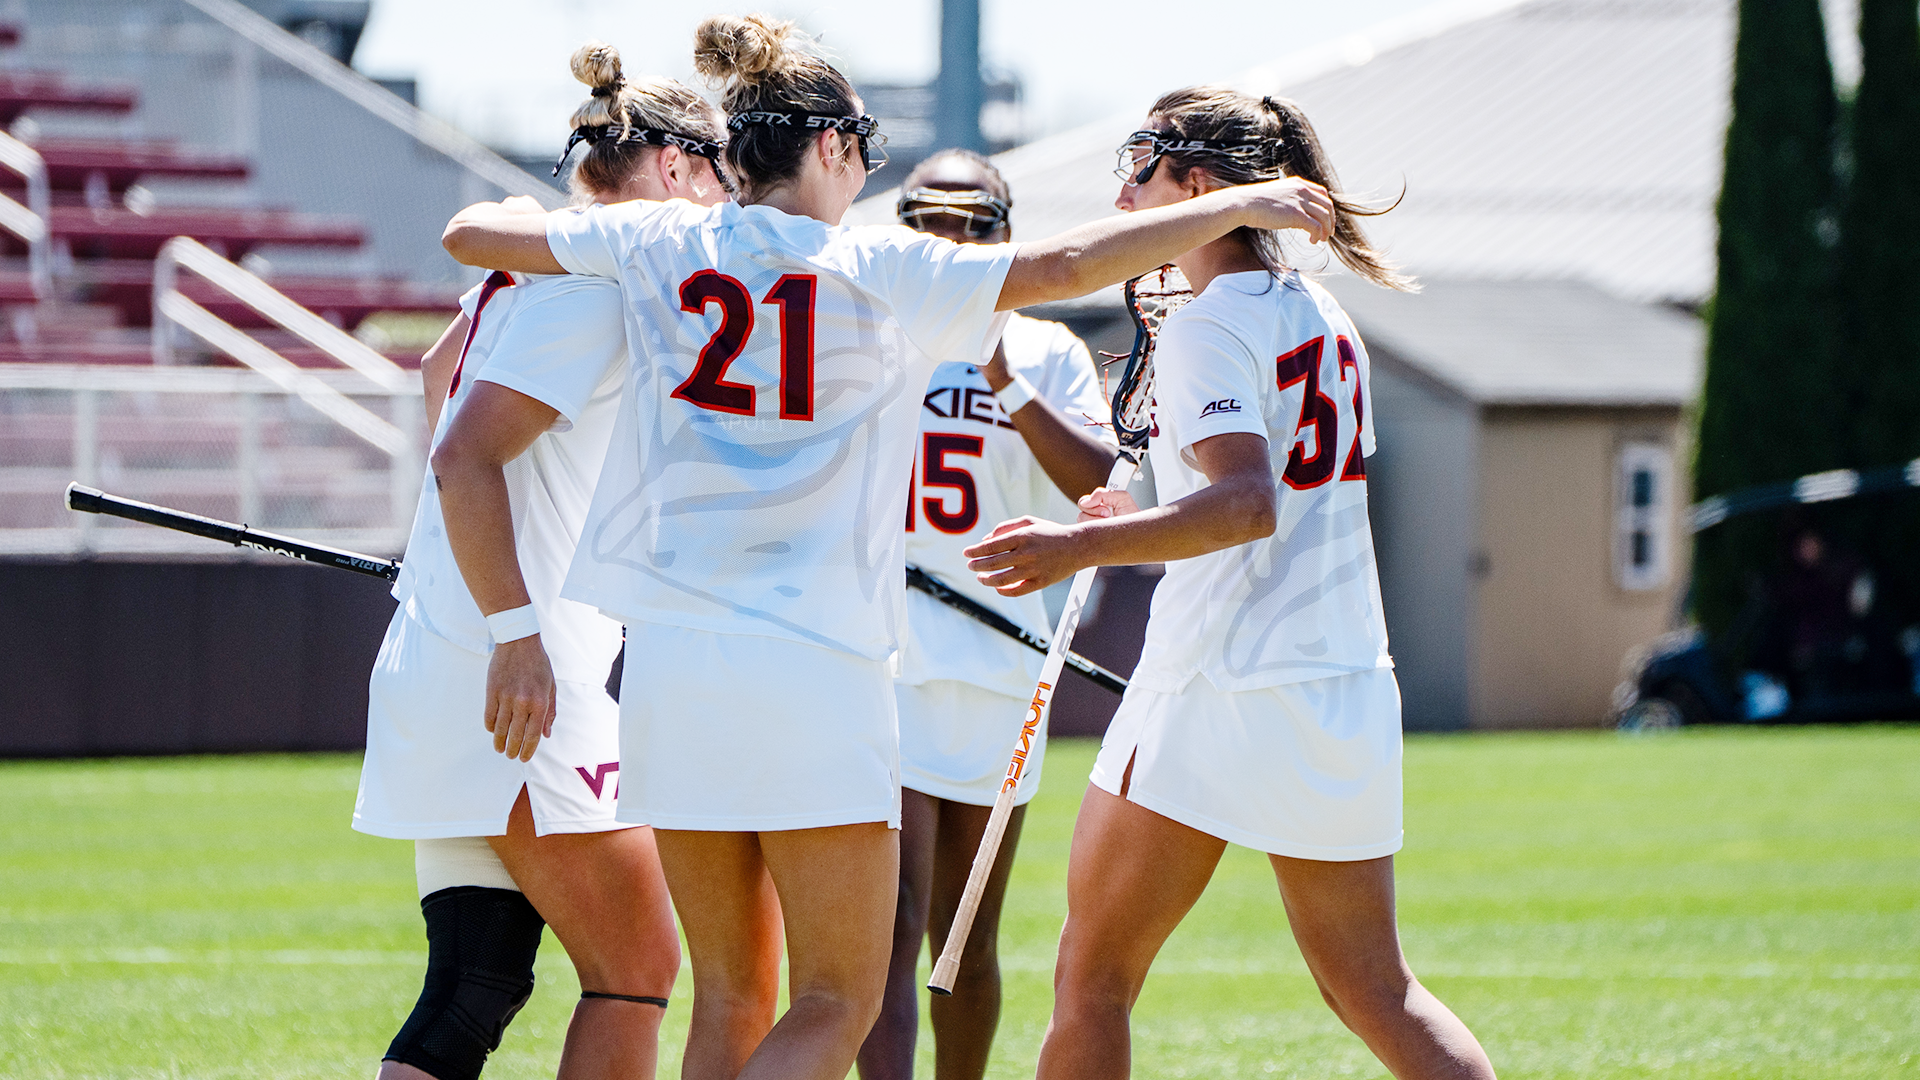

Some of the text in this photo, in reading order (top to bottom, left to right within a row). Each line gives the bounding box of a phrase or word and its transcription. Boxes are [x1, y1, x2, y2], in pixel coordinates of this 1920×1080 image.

[750, 112, 792, 126] STX
[805, 115, 845, 131] STX
[670, 268, 818, 422] 21
[1201, 398, 1242, 415] ACC
[1276, 334, 1367, 490] 32
[350, 557, 386, 573] ARIA
